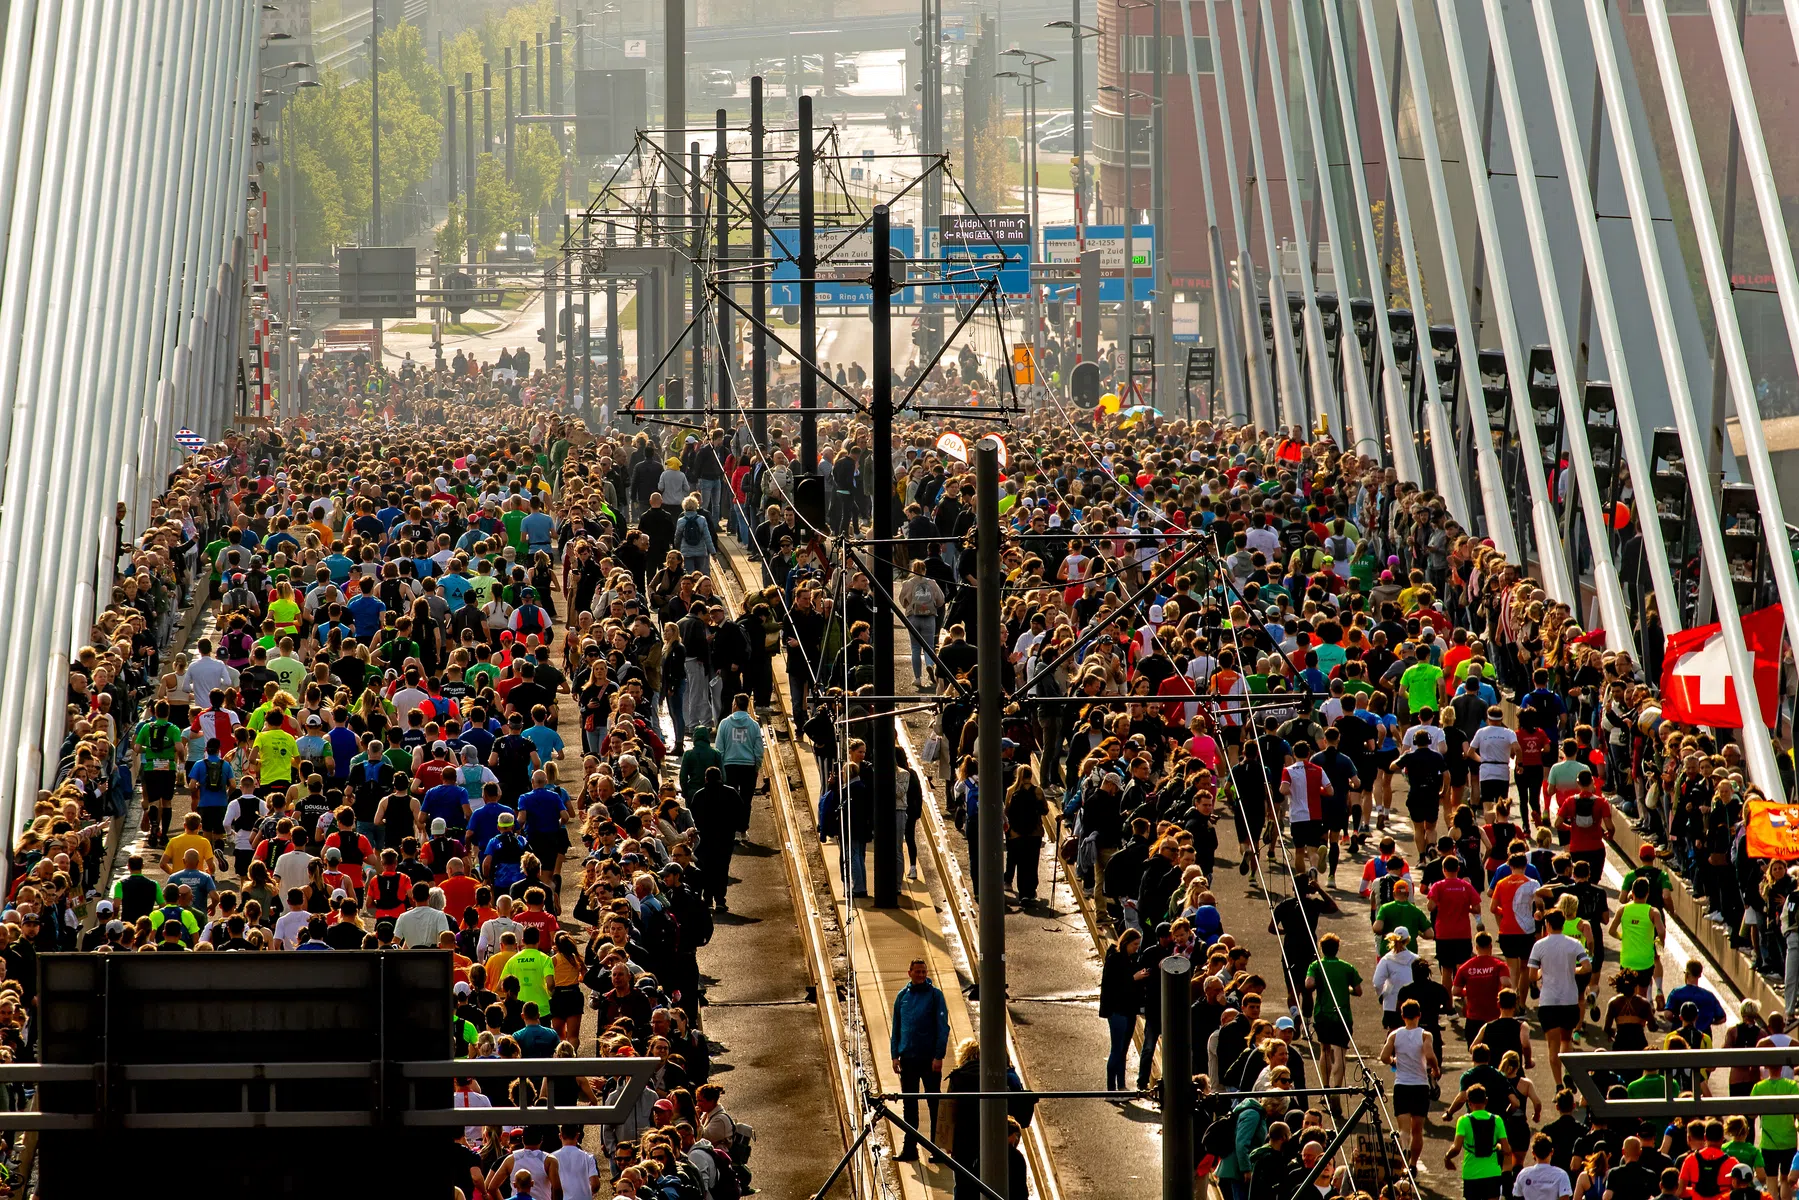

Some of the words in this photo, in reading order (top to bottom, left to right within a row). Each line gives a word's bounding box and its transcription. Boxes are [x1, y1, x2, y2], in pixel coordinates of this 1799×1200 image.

[989, 219, 996, 227] 11
[999, 219, 1015, 227] min
[996, 231, 1005, 239] 18
[1008, 230, 1023, 239] min
[840, 294, 857, 302] Ring
[1477, 967, 1494, 975] KWF
